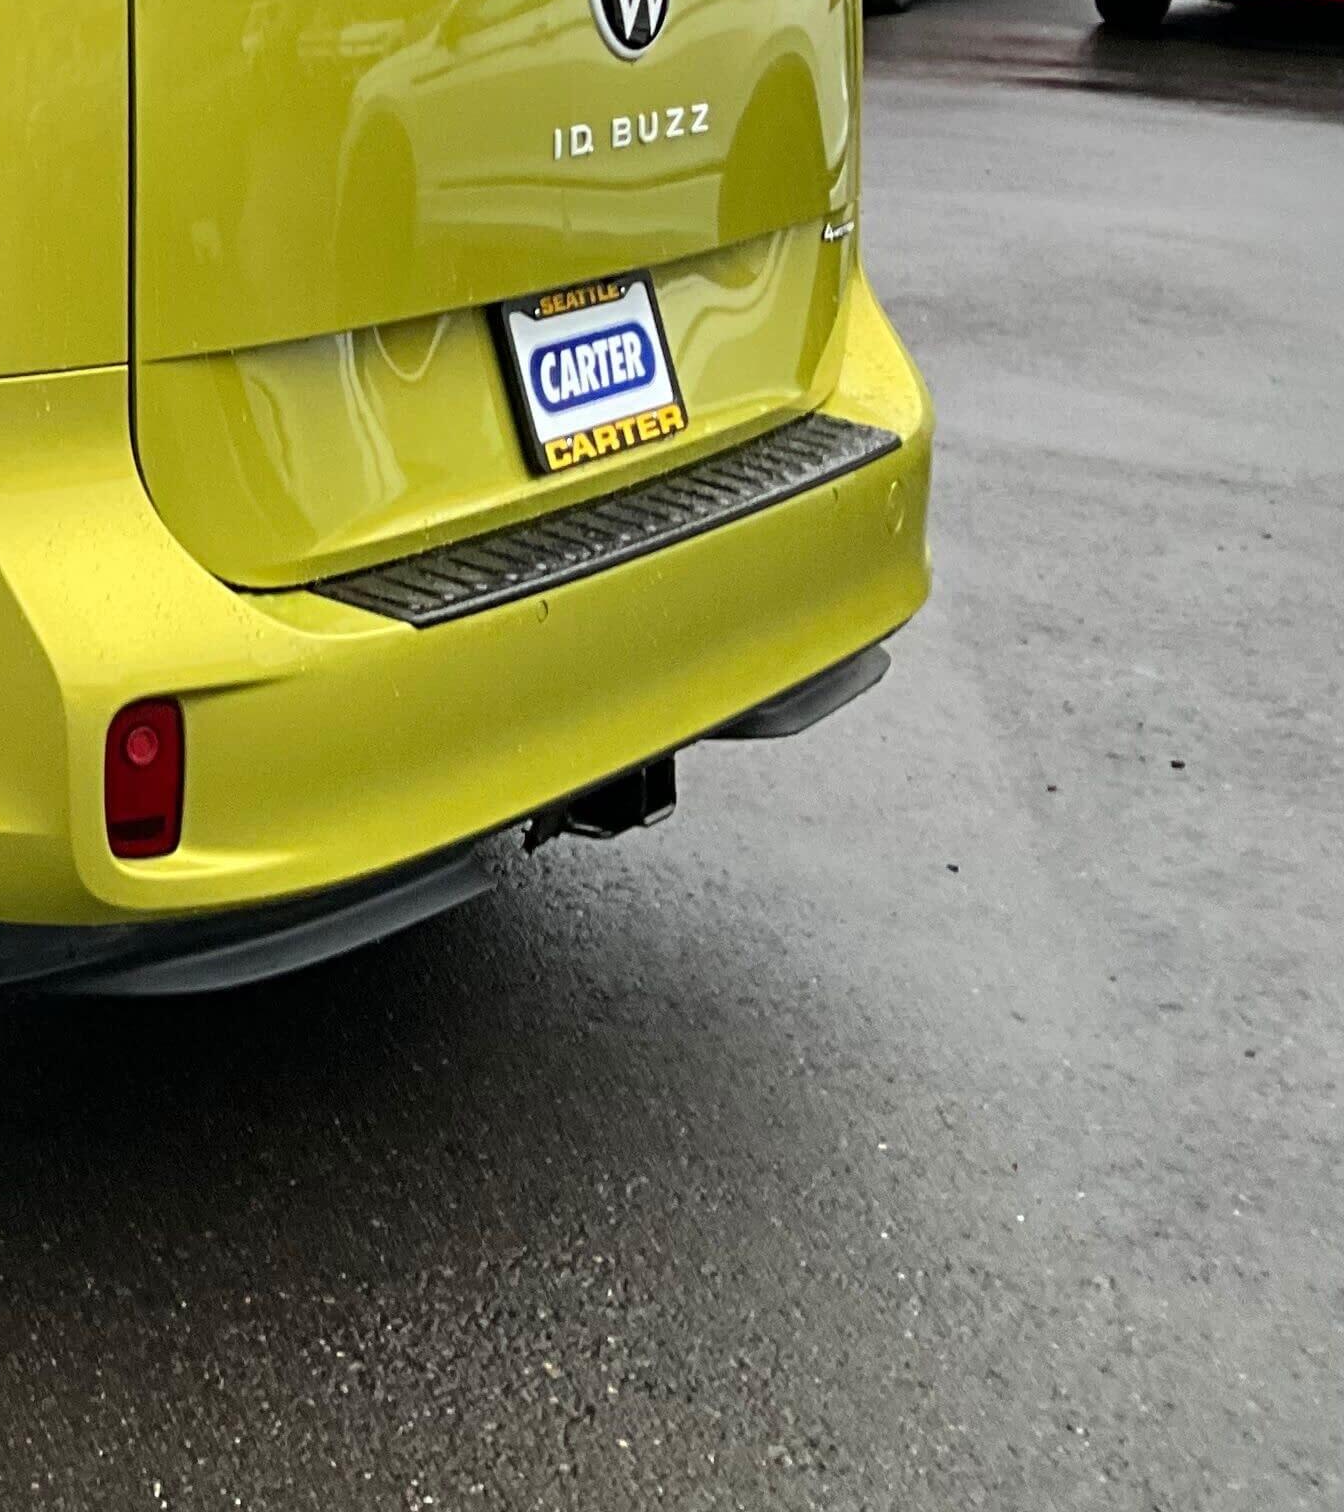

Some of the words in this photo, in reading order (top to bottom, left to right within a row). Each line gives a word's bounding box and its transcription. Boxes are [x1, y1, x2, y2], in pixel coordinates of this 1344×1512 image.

[611, 102, 710, 149] BUZZ
[539, 284, 621, 316] SEATTLE
[539, 330, 646, 405] CARTER
[544, 403, 685, 471] CARTER
